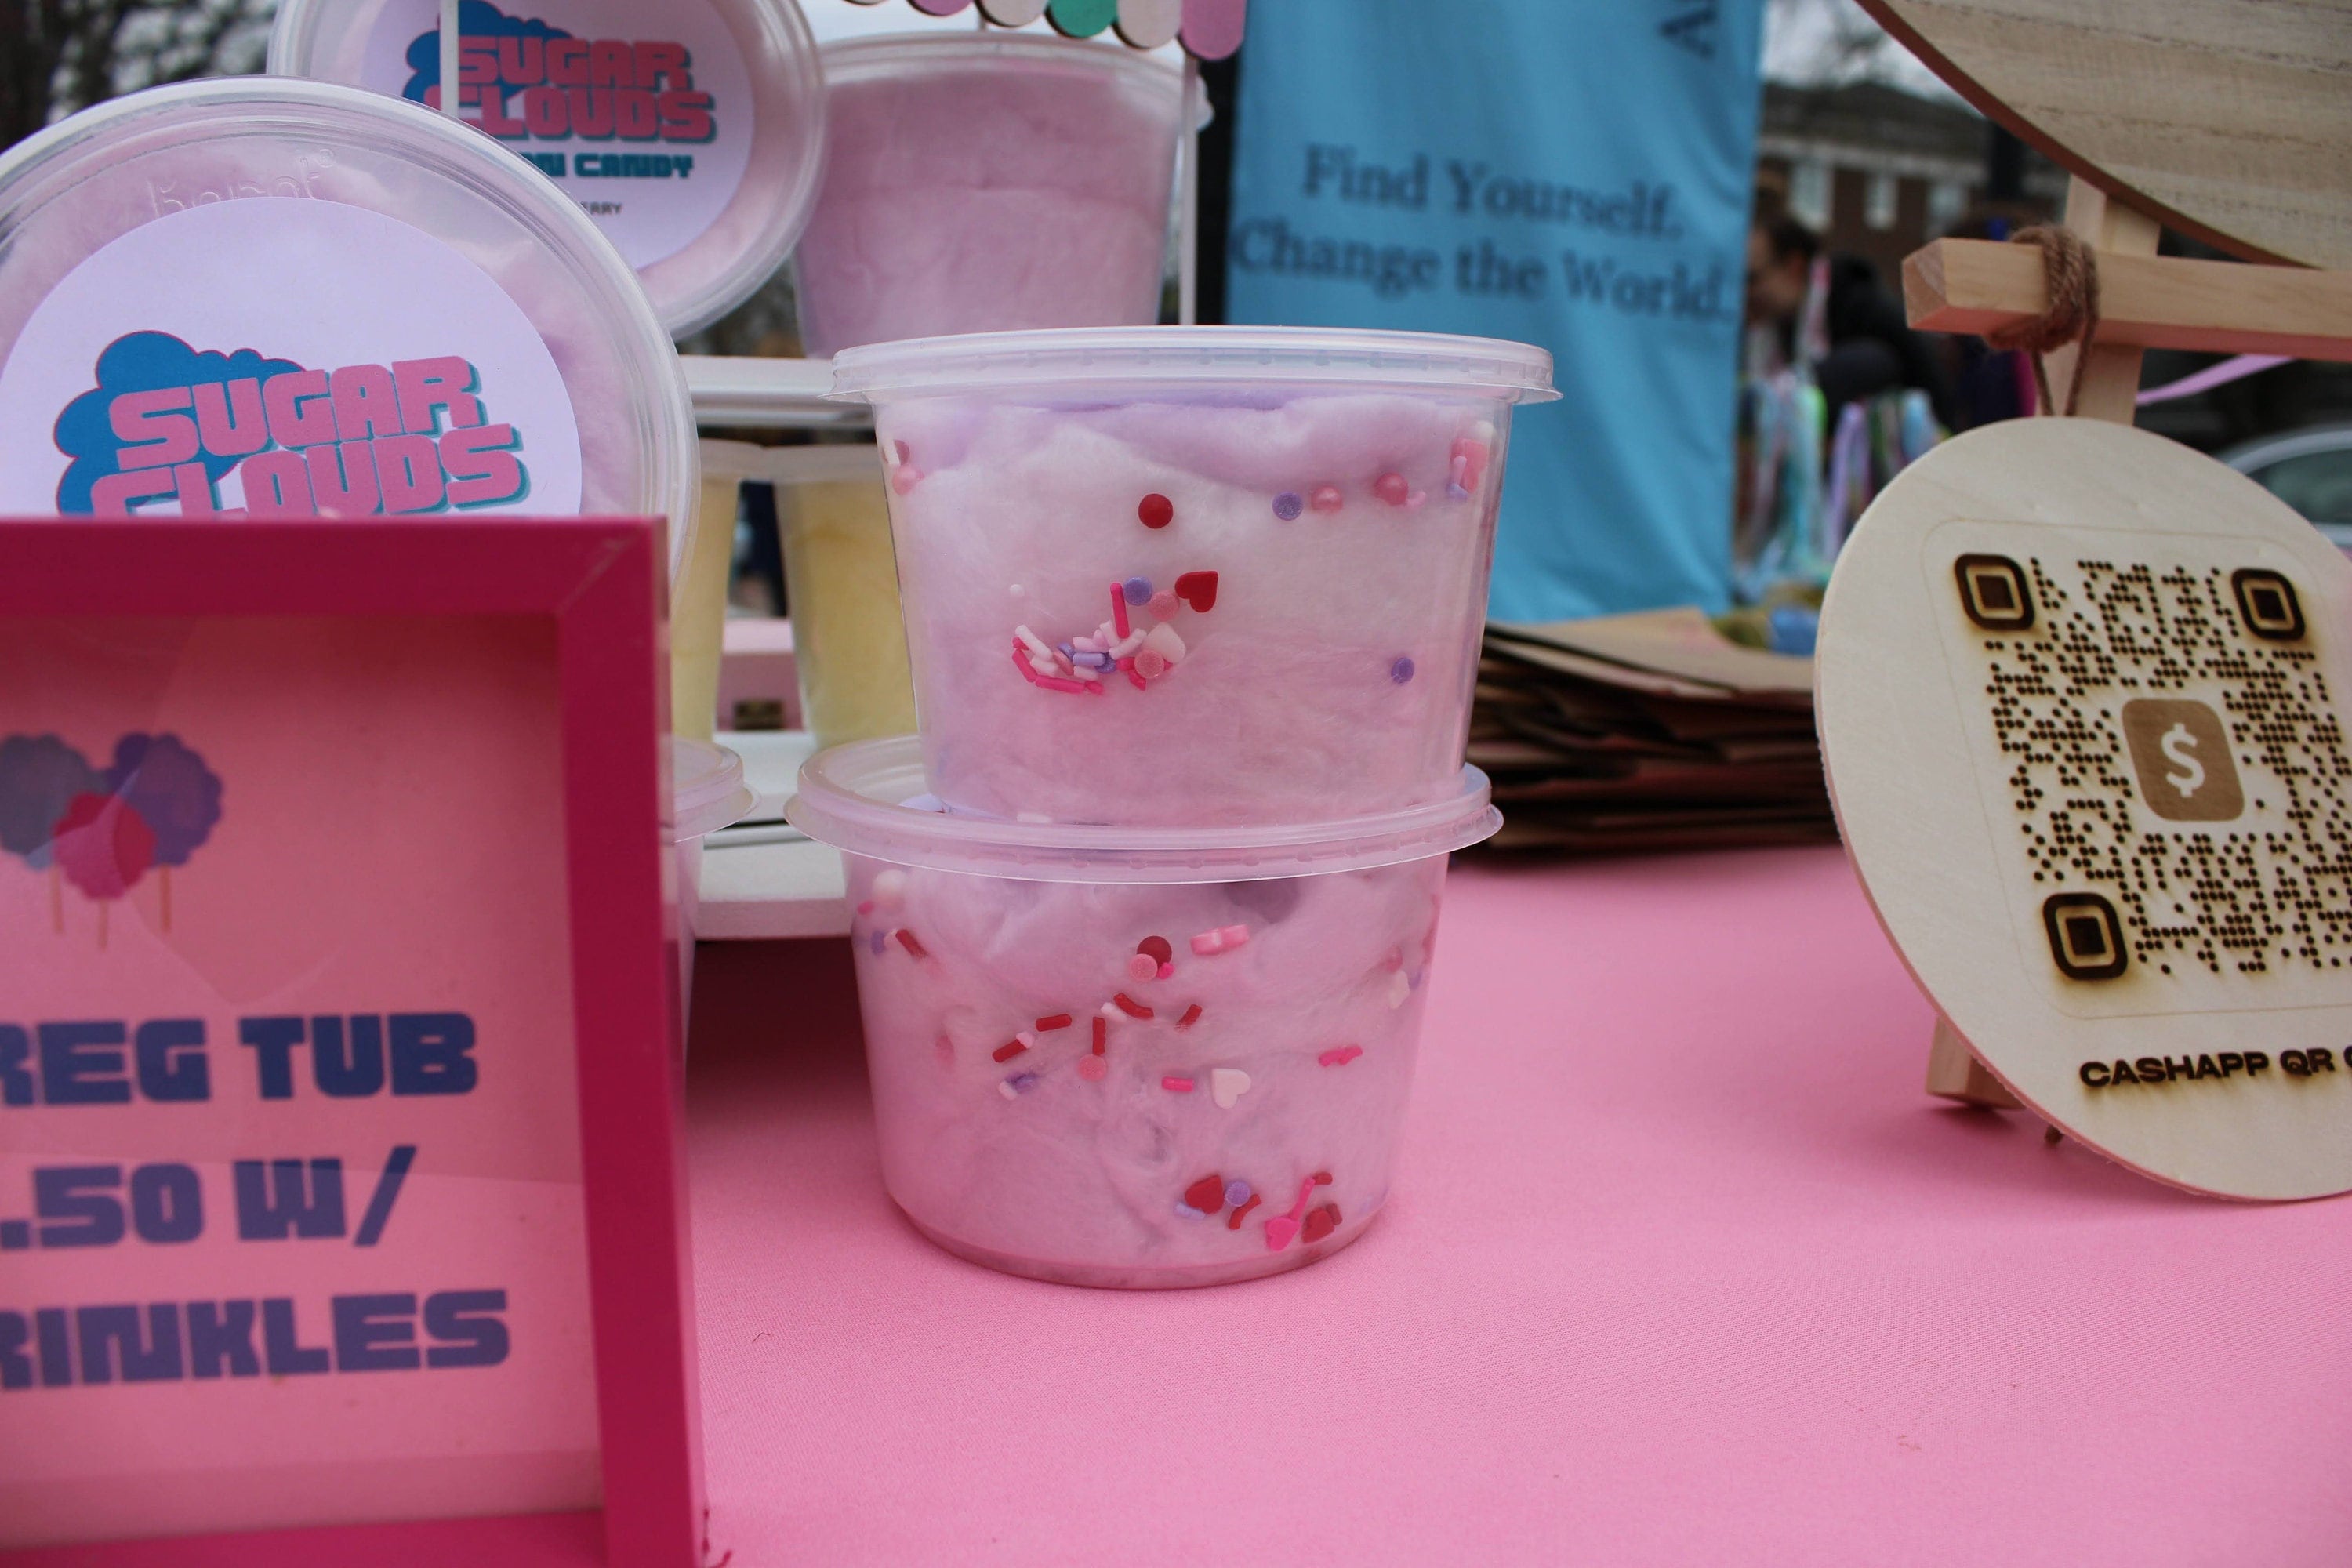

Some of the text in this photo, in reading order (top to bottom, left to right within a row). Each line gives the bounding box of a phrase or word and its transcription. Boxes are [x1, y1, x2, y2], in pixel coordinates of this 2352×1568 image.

[459, 36, 693, 91] SUGAR
[575, 154, 693, 177] CANDY
[1305, 143, 1683, 240] Find Yourself.
[1229, 218, 1442, 299] Change
[1456, 239, 1548, 301] the
[108, 356, 488, 470] SUGAR
[90, 423, 531, 519] CLOUDS
[238, 1011, 477, 1101] TUB
[2079, 1051, 2270, 1087] CASHAPP
[2279, 1047, 2335, 1076] QR
